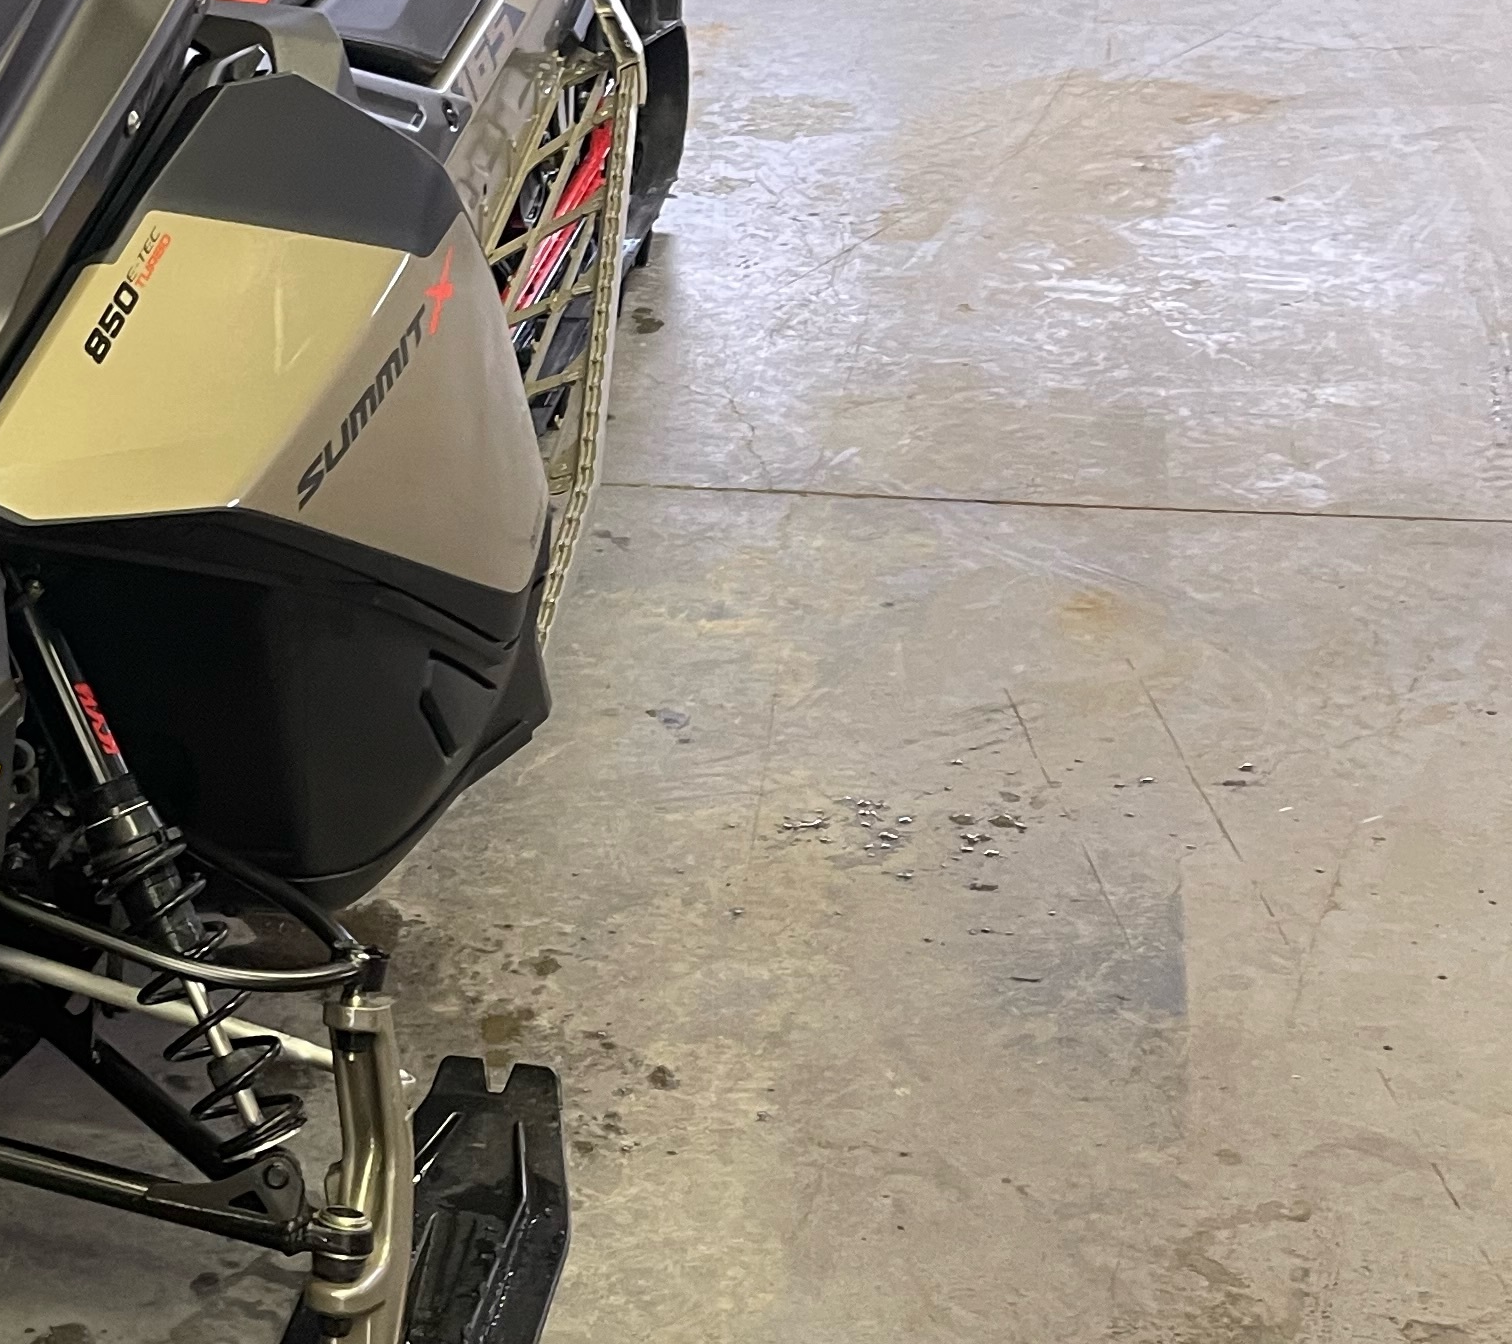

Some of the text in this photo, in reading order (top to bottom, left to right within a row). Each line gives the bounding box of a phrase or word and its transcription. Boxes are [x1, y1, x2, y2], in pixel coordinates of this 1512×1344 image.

[85, 225, 161, 364] 850 E-TEC
[135, 233, 171, 288] TURBO
[297, 303, 426, 512] SUMMIT
